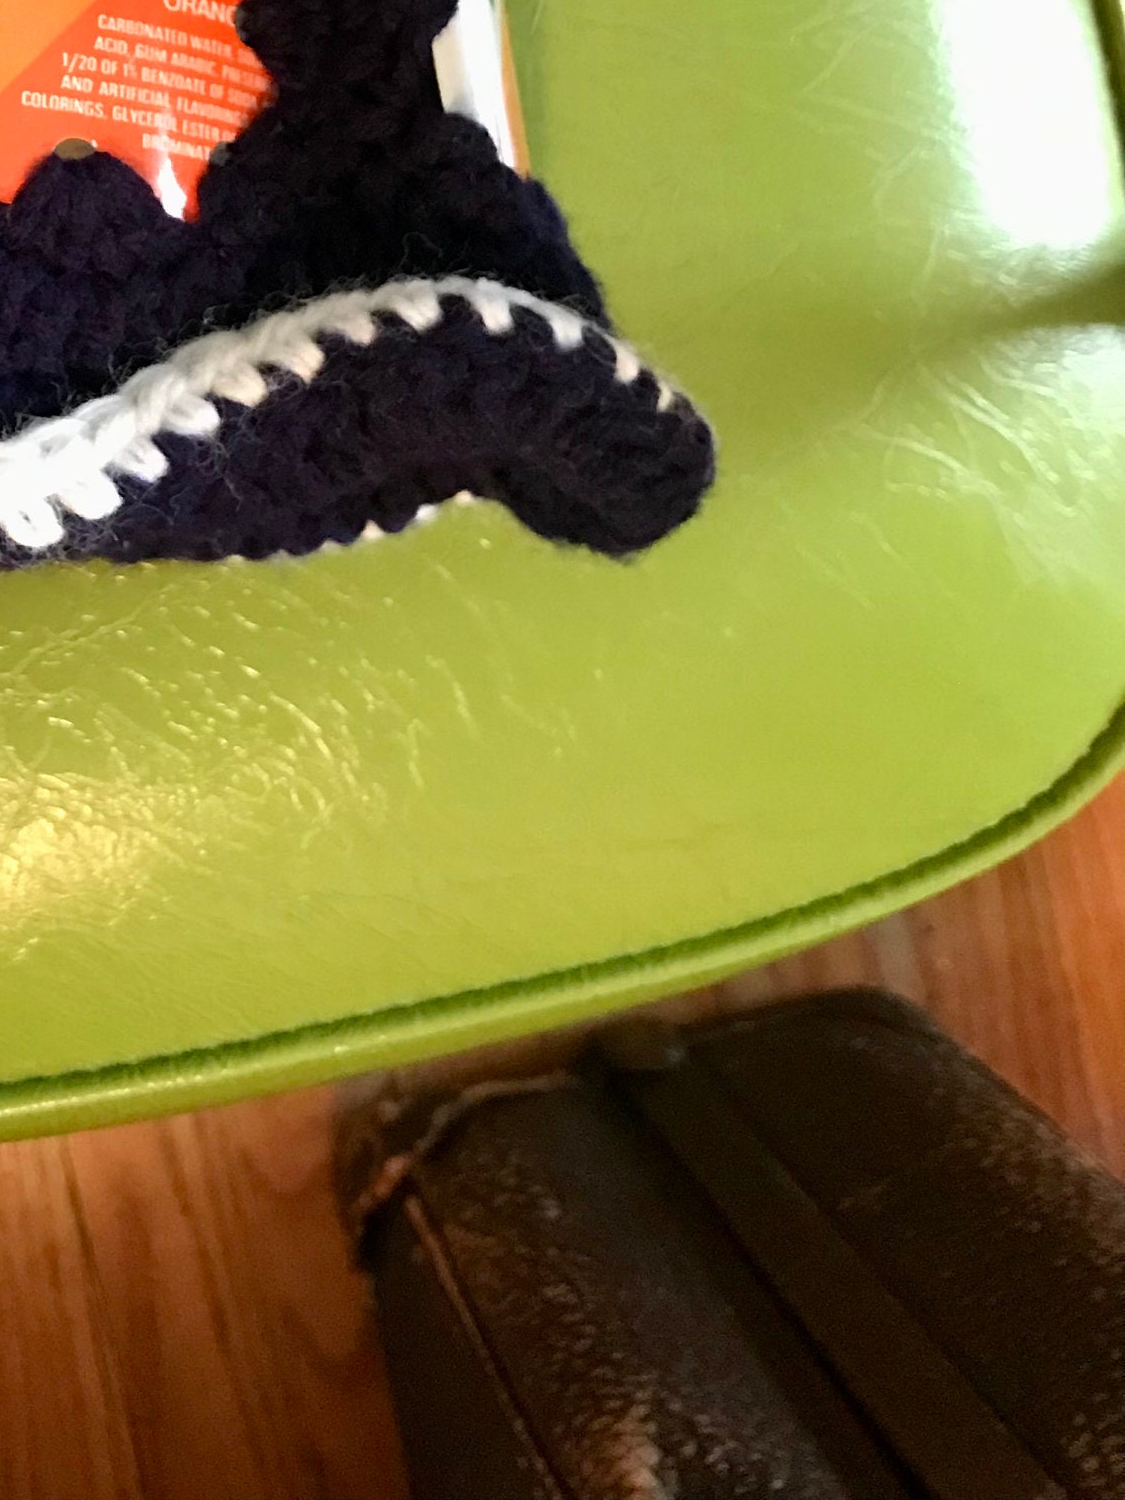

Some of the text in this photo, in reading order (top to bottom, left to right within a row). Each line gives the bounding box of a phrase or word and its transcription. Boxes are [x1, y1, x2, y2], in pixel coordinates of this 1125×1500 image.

[97, 14, 188, 47] CARBONATED
[134, 43, 168, 63] GUM
[61, 52, 97, 74] 1/20
[101, 59, 118, 75] OF
[140, 66, 207, 95] BENZOATE
[60, 74, 94, 93] AND
[98, 81, 171, 109] ARTIFICIAL
[182, 120, 220, 143] ESTER
